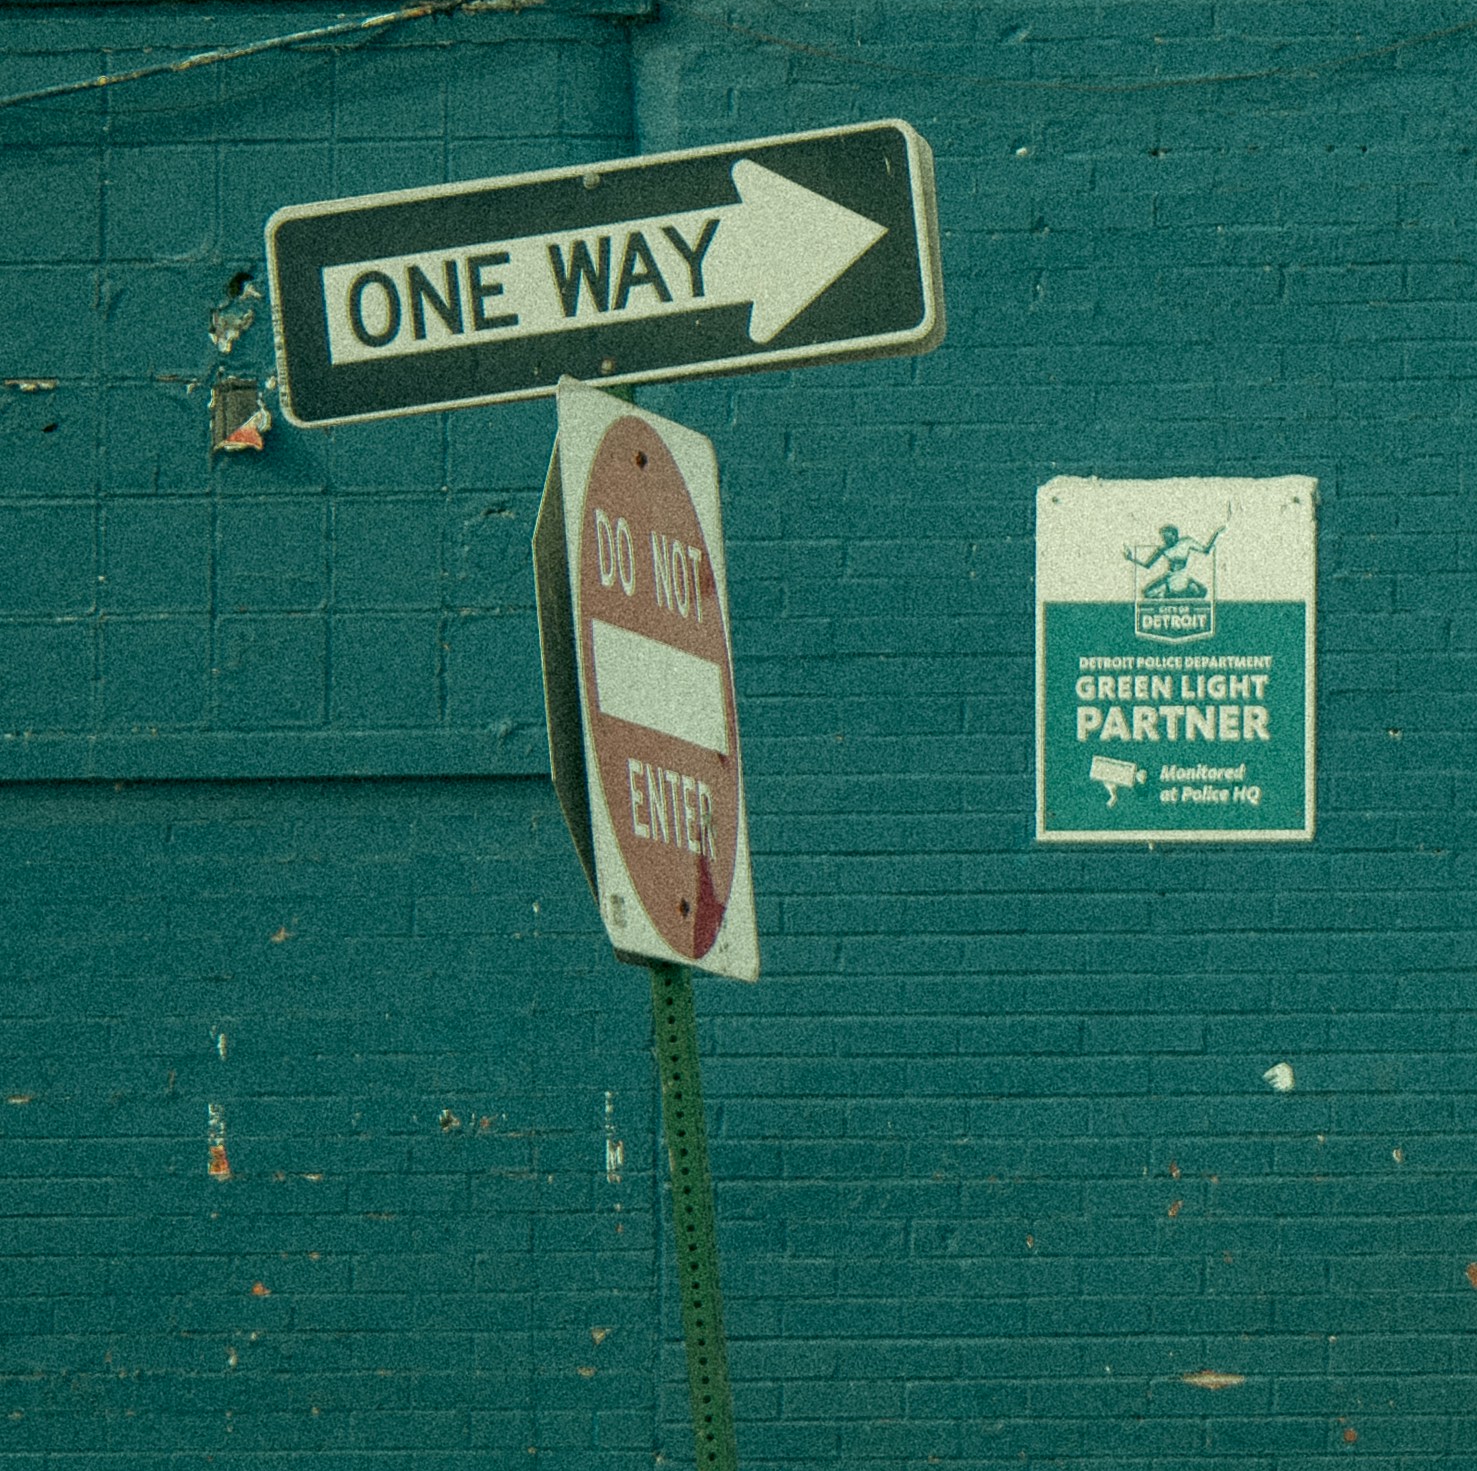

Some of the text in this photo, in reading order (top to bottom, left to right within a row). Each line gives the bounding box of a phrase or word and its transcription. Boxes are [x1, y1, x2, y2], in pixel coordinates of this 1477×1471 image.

[347, 218, 722, 349] ONE WAY
[594, 508, 702, 624] DO NOT
[1142, 614, 1207, 630] DETROIT
[1079, 656, 1272, 671] DETROIT POLICE DEPARTMENT
[1075, 675, 1269, 701] GREEN LIGHT
[1076, 705, 1270, 741] PARTNER
[1160, 762, 1246, 782] Monitored
[1160, 785, 1261, 806] at Police HQ
[627, 757, 718, 862] ENTER
